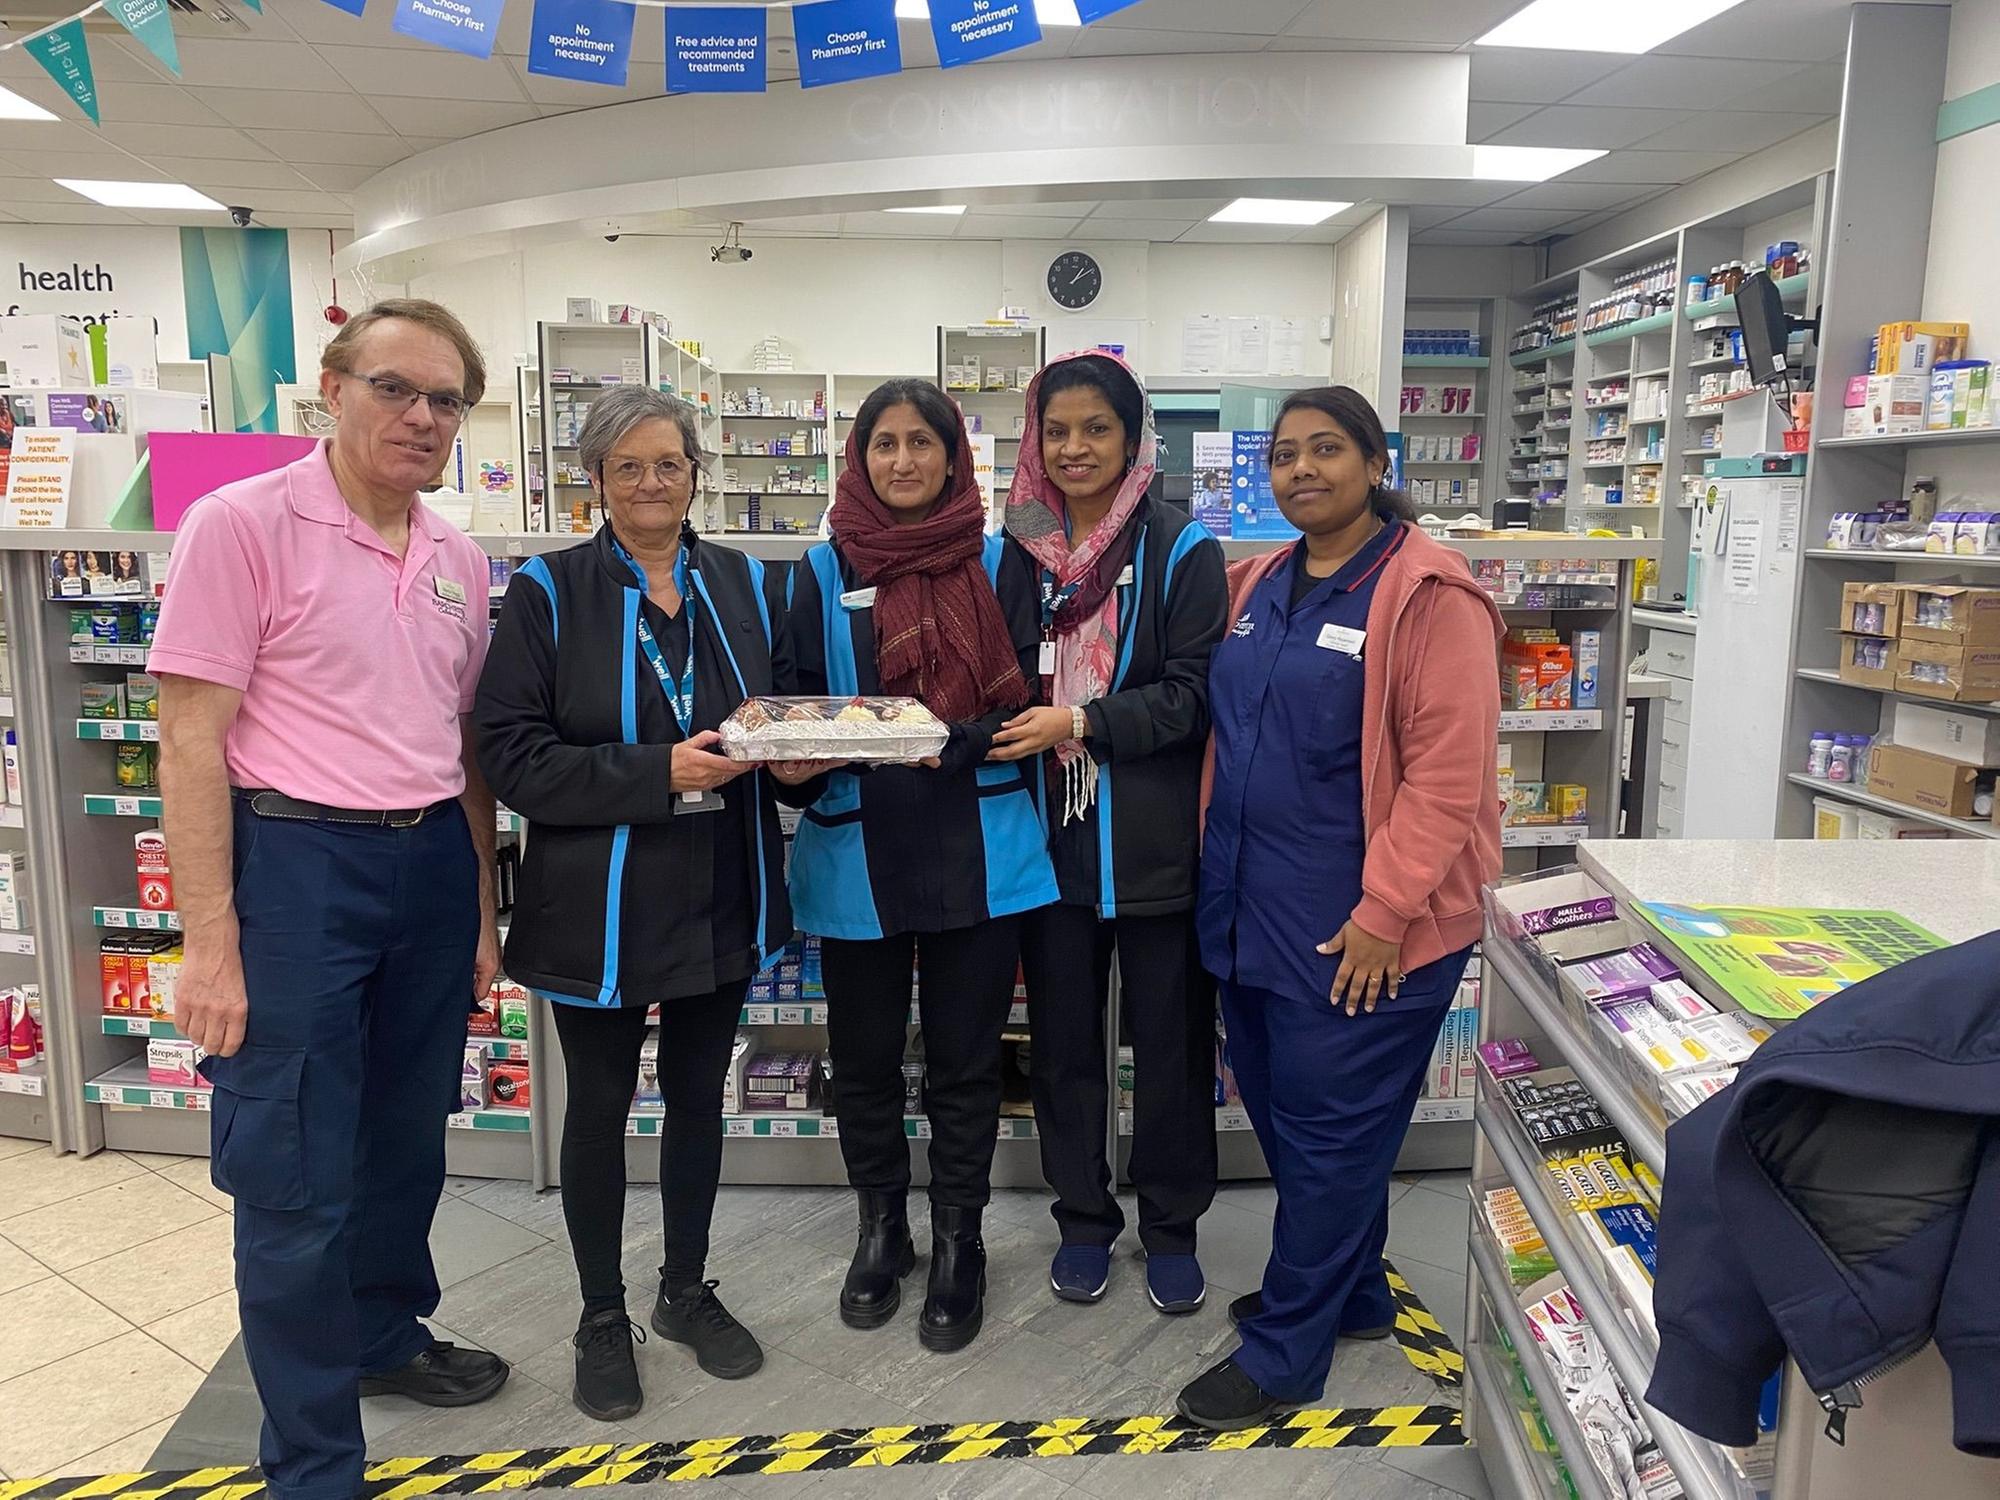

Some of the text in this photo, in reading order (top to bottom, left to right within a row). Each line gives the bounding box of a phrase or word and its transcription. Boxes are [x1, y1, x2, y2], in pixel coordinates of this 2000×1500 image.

[127, 0, 158, 22] Doctor
[973, 0, 990, 12] No
[412, 1, 485, 32] Pharmacy first
[951, 3, 1019, 33] appointment
[575, 23, 590, 36] No
[827, 30, 868, 44] Choose
[961, 19, 1014, 42] necessary
[548, 34, 615, 52] appointment
[675, 36, 757, 47] Free advice and
[811, 38, 886, 60] Pharmacy first
[555, 48, 606, 66] necessary
[679, 48, 754, 60] recommended
[688, 62, 745, 72] treatments
[19, 262, 113, 292] health
[1552, 911, 1594, 926] Soothers
[1557, 906, 1585, 917] HALLS
[779, 983, 796, 991] DEEP
[1444, 1011, 1457, 1065] Bepanthen
[1461, 1011, 1471, 1062] Bepanthen
[150, 1047, 183, 1059] Strepsils
[1578, 1142, 1623, 1158] HALLS
[1570, 1166, 1598, 1196] LOCKETS
[1594, 1161, 1621, 1191] LOCKETS
